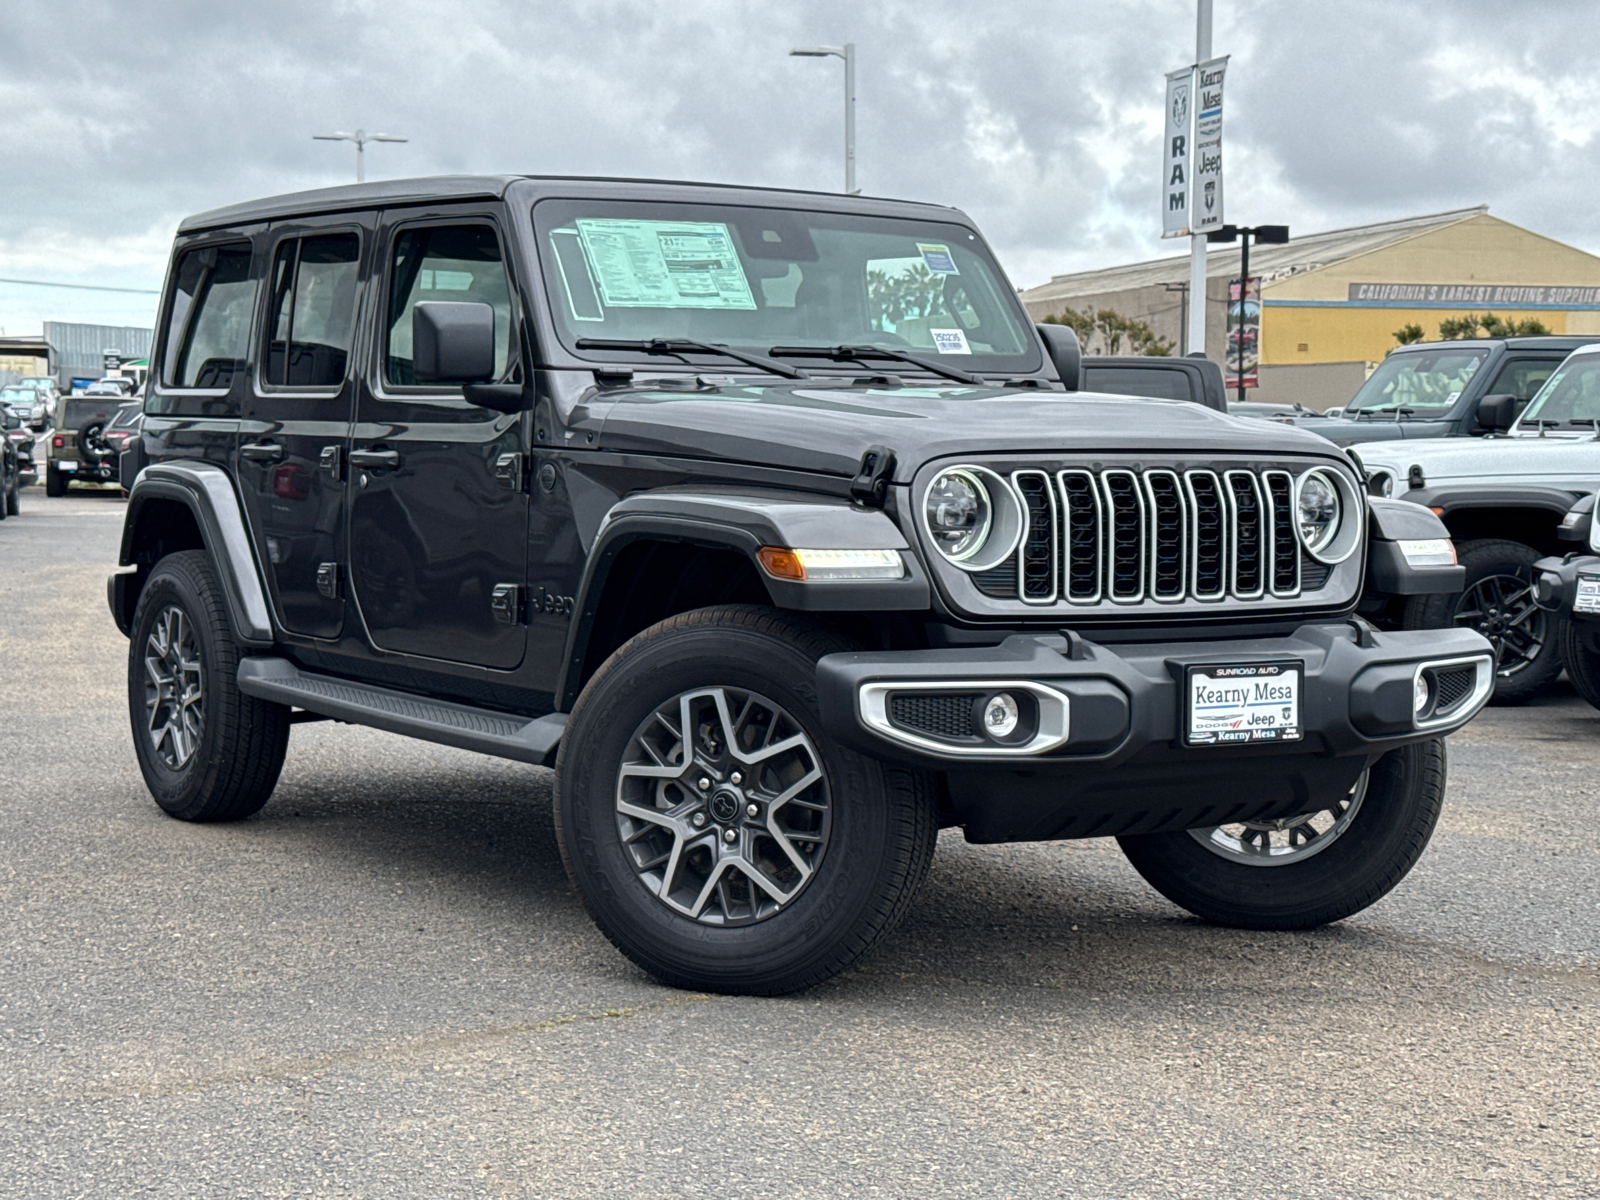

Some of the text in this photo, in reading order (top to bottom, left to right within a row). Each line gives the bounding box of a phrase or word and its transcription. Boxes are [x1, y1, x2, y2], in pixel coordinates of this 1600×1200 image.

[1200, 69, 1225, 89] Kearny
[1202, 90, 1221, 110] Mesa
[1169, 135, 1185, 211] RAM
[1199, 152, 1221, 176] Jeep
[1201, 216, 1217, 225] RAM
[1358, 285, 1438, 301] CALIFORNIA'S
[1441, 286, 1492, 302] LARGEST
[1494, 287, 1545, 303] ROOFING
[532, 586, 575, 621] Jeep
[1216, 666, 1279, 676] SUNROAD AUTO
[1195, 682, 1293, 708] Kearny Mesa
[1247, 713, 1275, 727] Jeep
[1218, 730, 1251, 742] Kearny
[1252, 729, 1276, 739] Mesa
